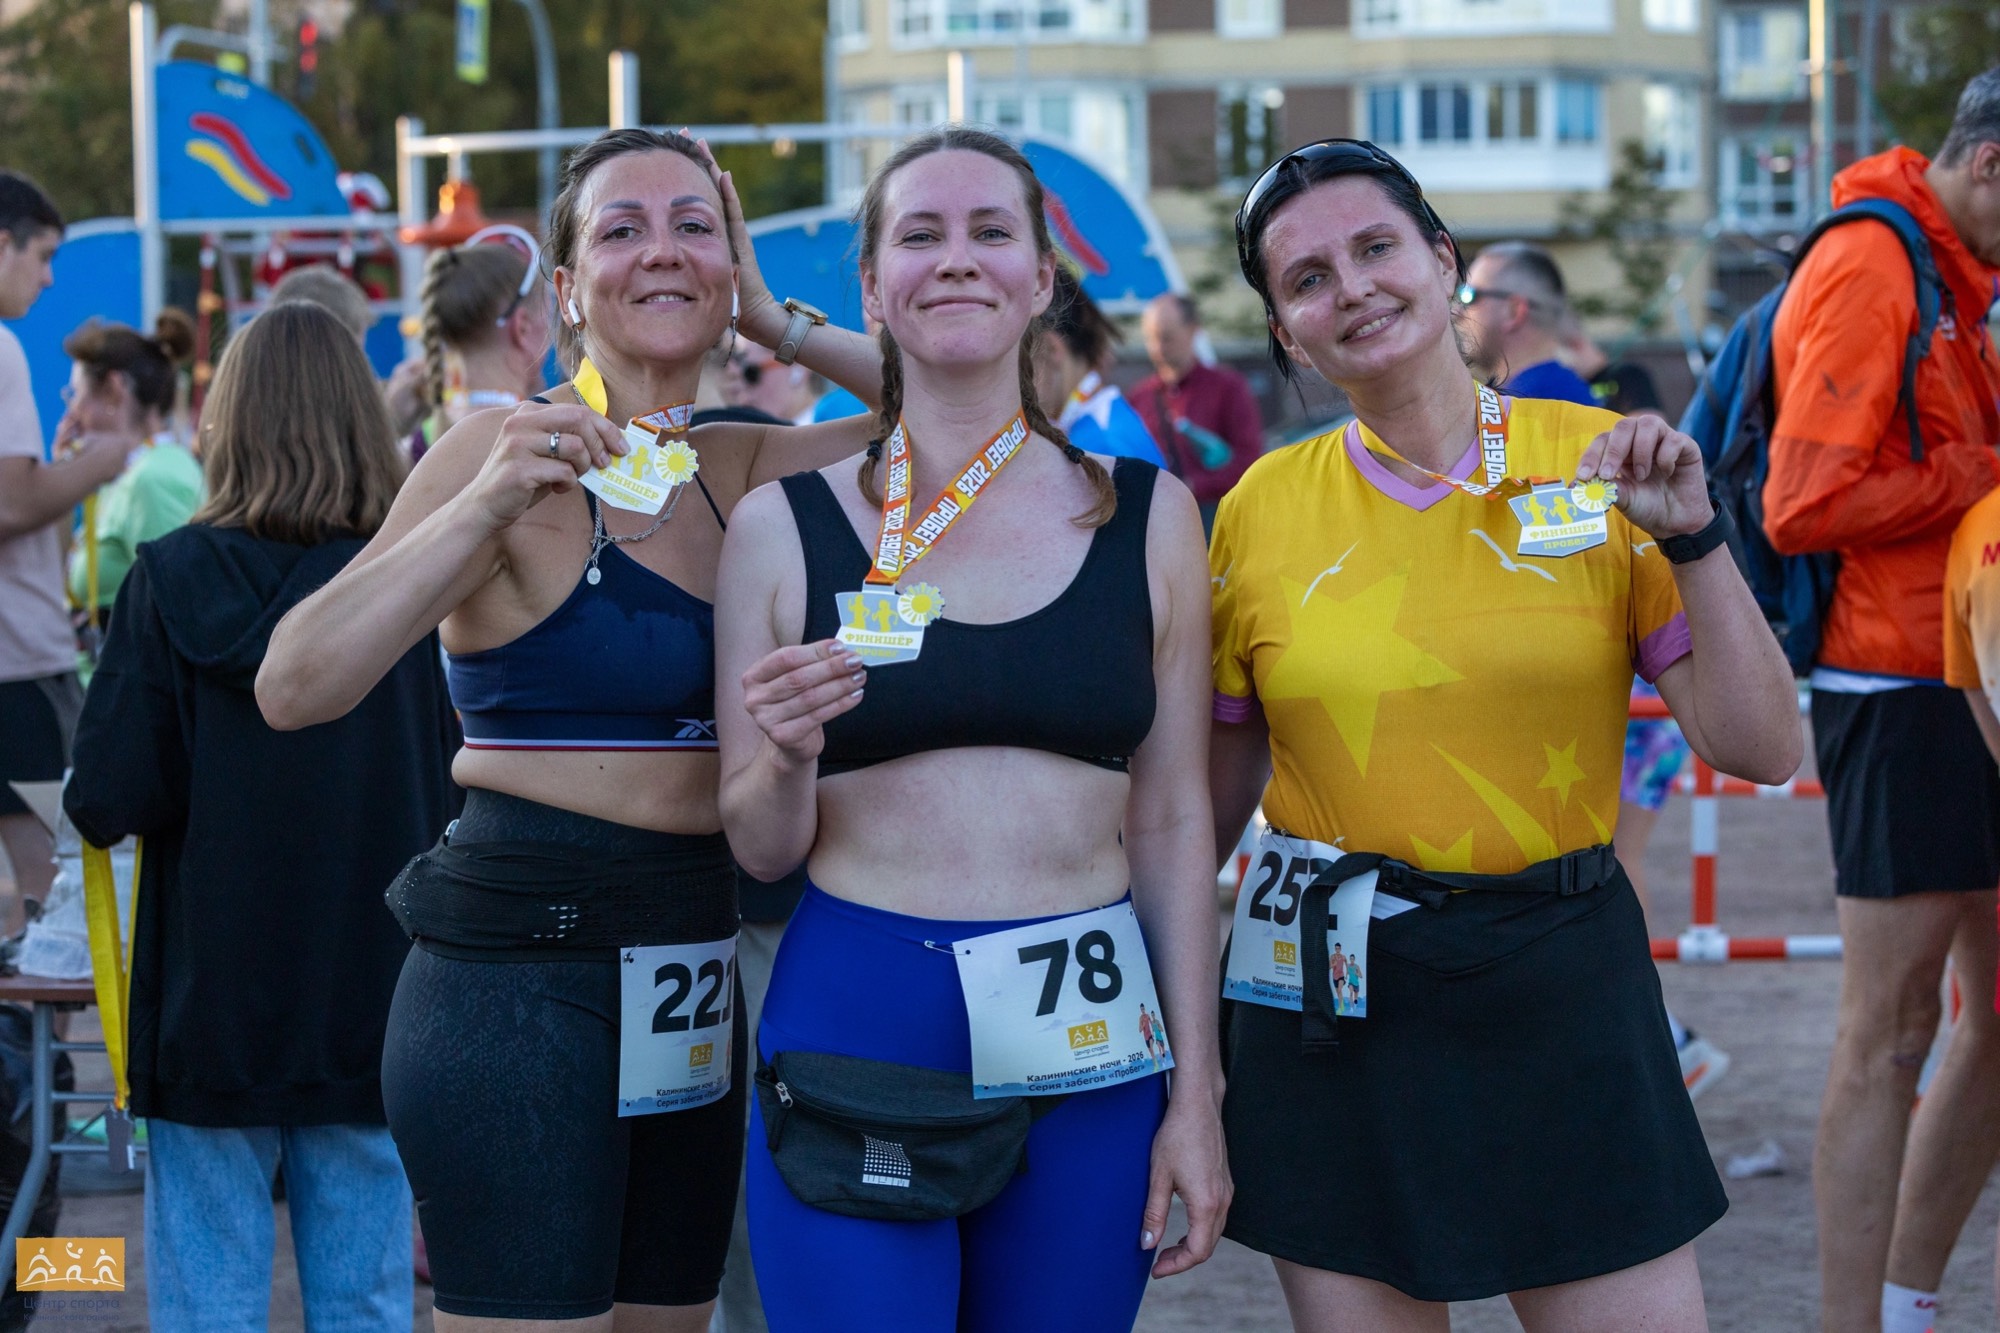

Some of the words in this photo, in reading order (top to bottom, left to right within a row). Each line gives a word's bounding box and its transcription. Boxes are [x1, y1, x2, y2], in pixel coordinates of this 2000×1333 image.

[984, 417, 1027, 471] ПРОБЕГ
[887, 458, 908, 502] ПРОБЕГ
[954, 458, 992, 499] 2026
[884, 505, 906, 533] 2026
[912, 496, 962, 546] ПРОБЕГ
[1529, 523, 1598, 539] ФИНИШЁР
[876, 532, 903, 572] ПРОБЕГ
[845, 633, 913, 646] ФИНИШЁР
[1017, 929, 1123, 1017] 78
[652, 955, 735, 1034] 221
[1027, 1065, 1097, 1082] Калининские
[1099, 1060, 1121, 1070] ночи
[1128, 1051, 1144, 1063] 2026
[1029, 1082, 1061, 1091] Серия
[1064, 1076, 1106, 1088] забегов
[656, 1099, 678, 1108] Серия
